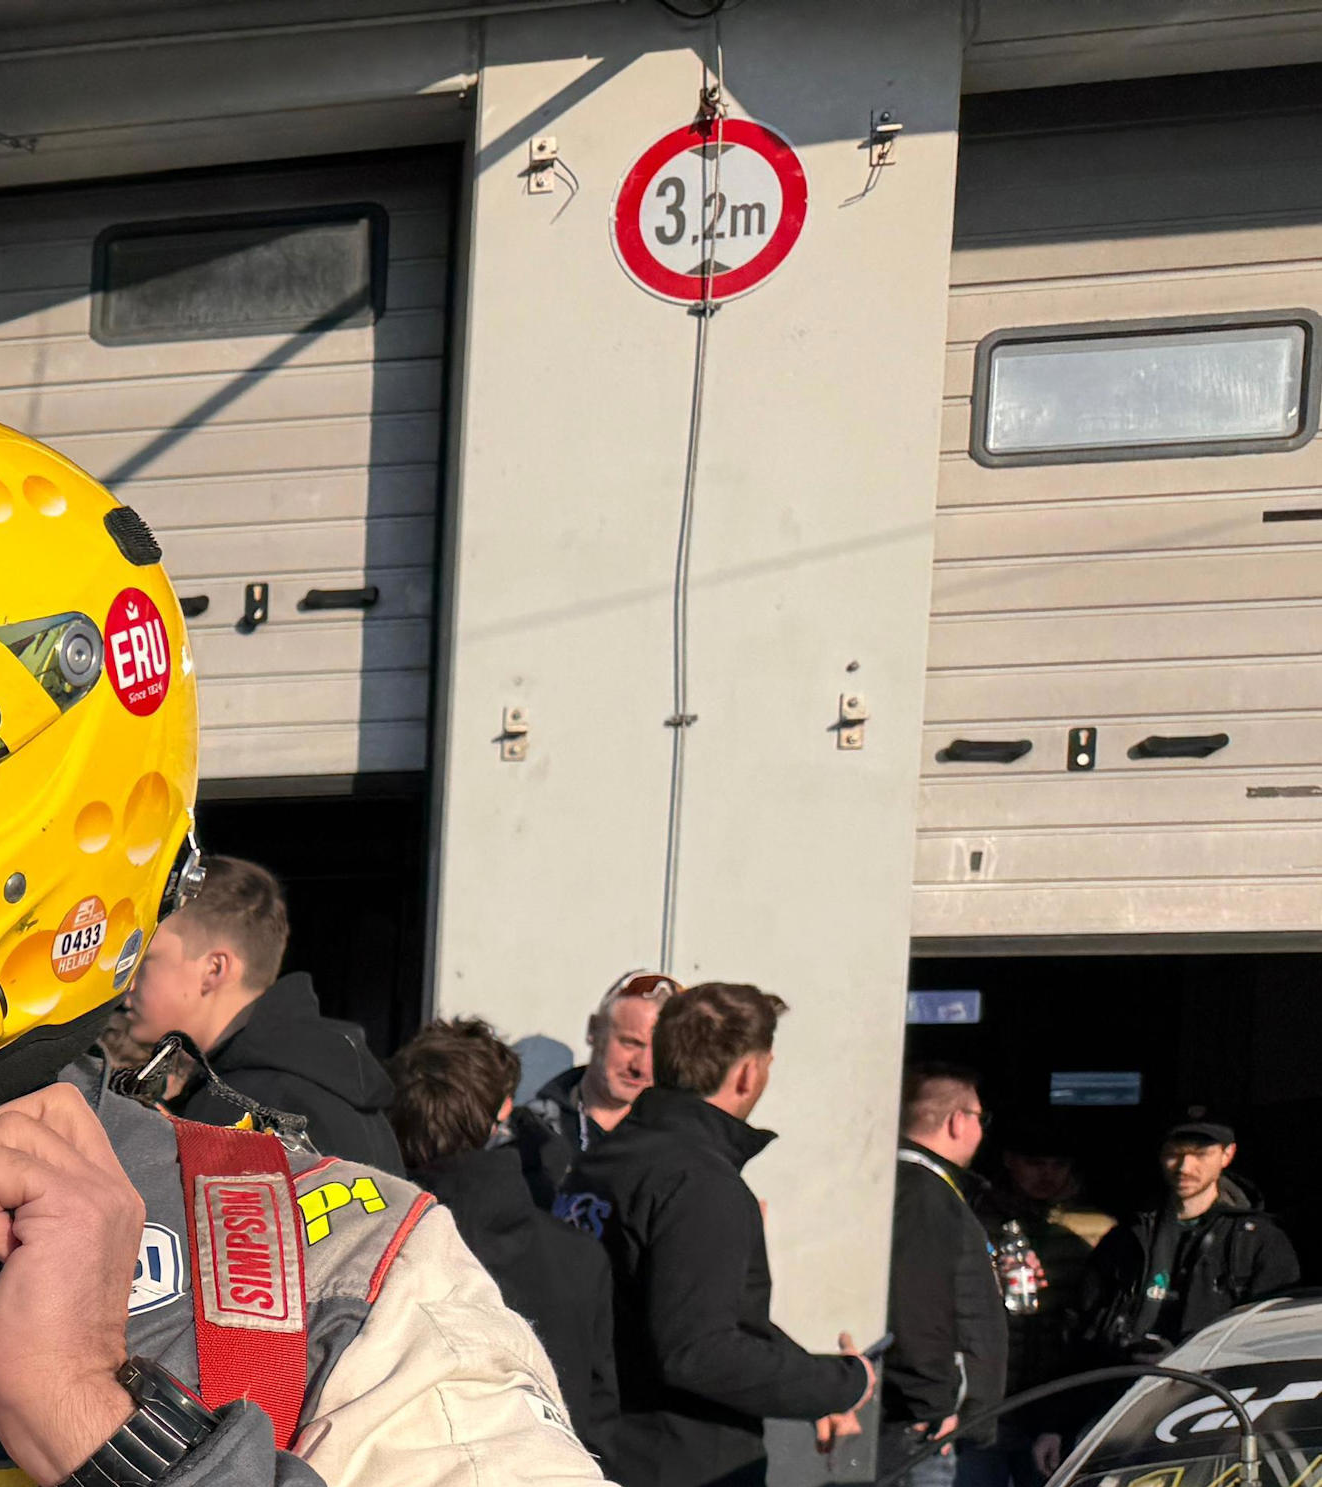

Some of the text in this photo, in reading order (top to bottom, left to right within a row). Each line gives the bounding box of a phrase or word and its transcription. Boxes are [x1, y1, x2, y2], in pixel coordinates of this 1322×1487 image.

[110, 618, 167, 690] ERU
[57, 949, 98, 975] HELMET
[61, 924, 101, 955] 0433
[218, 1188, 274, 1310] SIMPSON
